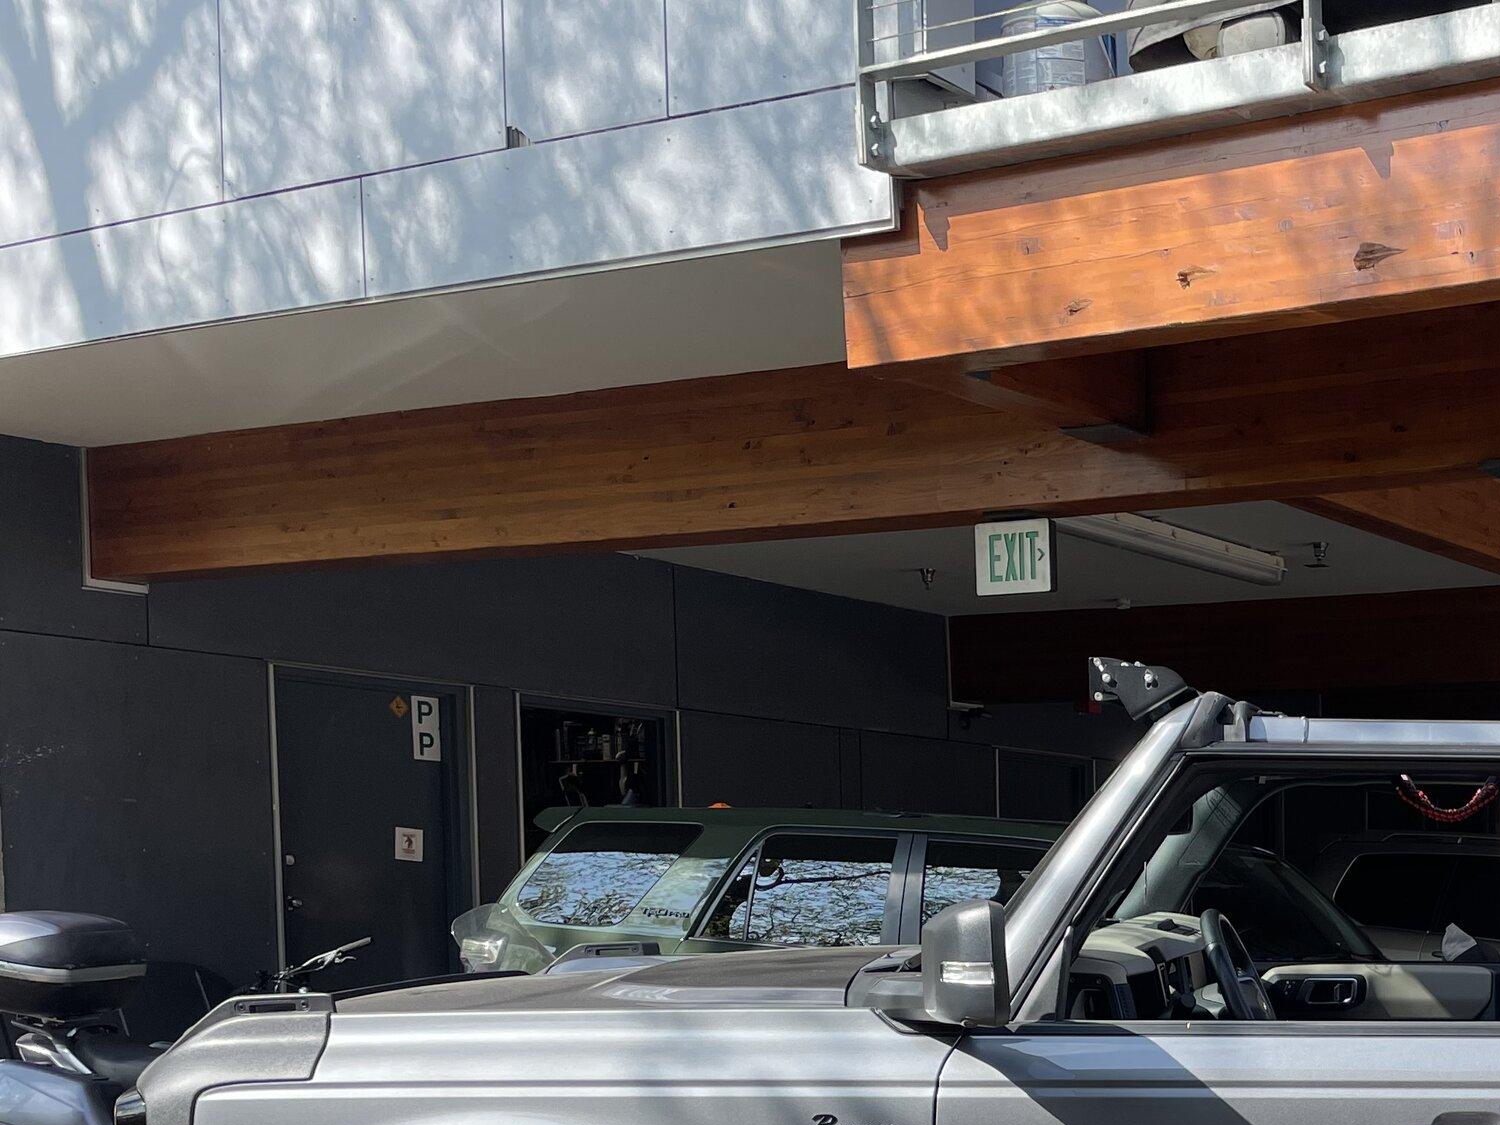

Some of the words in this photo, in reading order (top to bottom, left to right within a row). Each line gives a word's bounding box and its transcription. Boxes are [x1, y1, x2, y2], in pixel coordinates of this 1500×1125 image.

[989, 531, 1039, 582] EXIT
[416, 700, 433, 724] P
[418, 732, 435, 756] P
